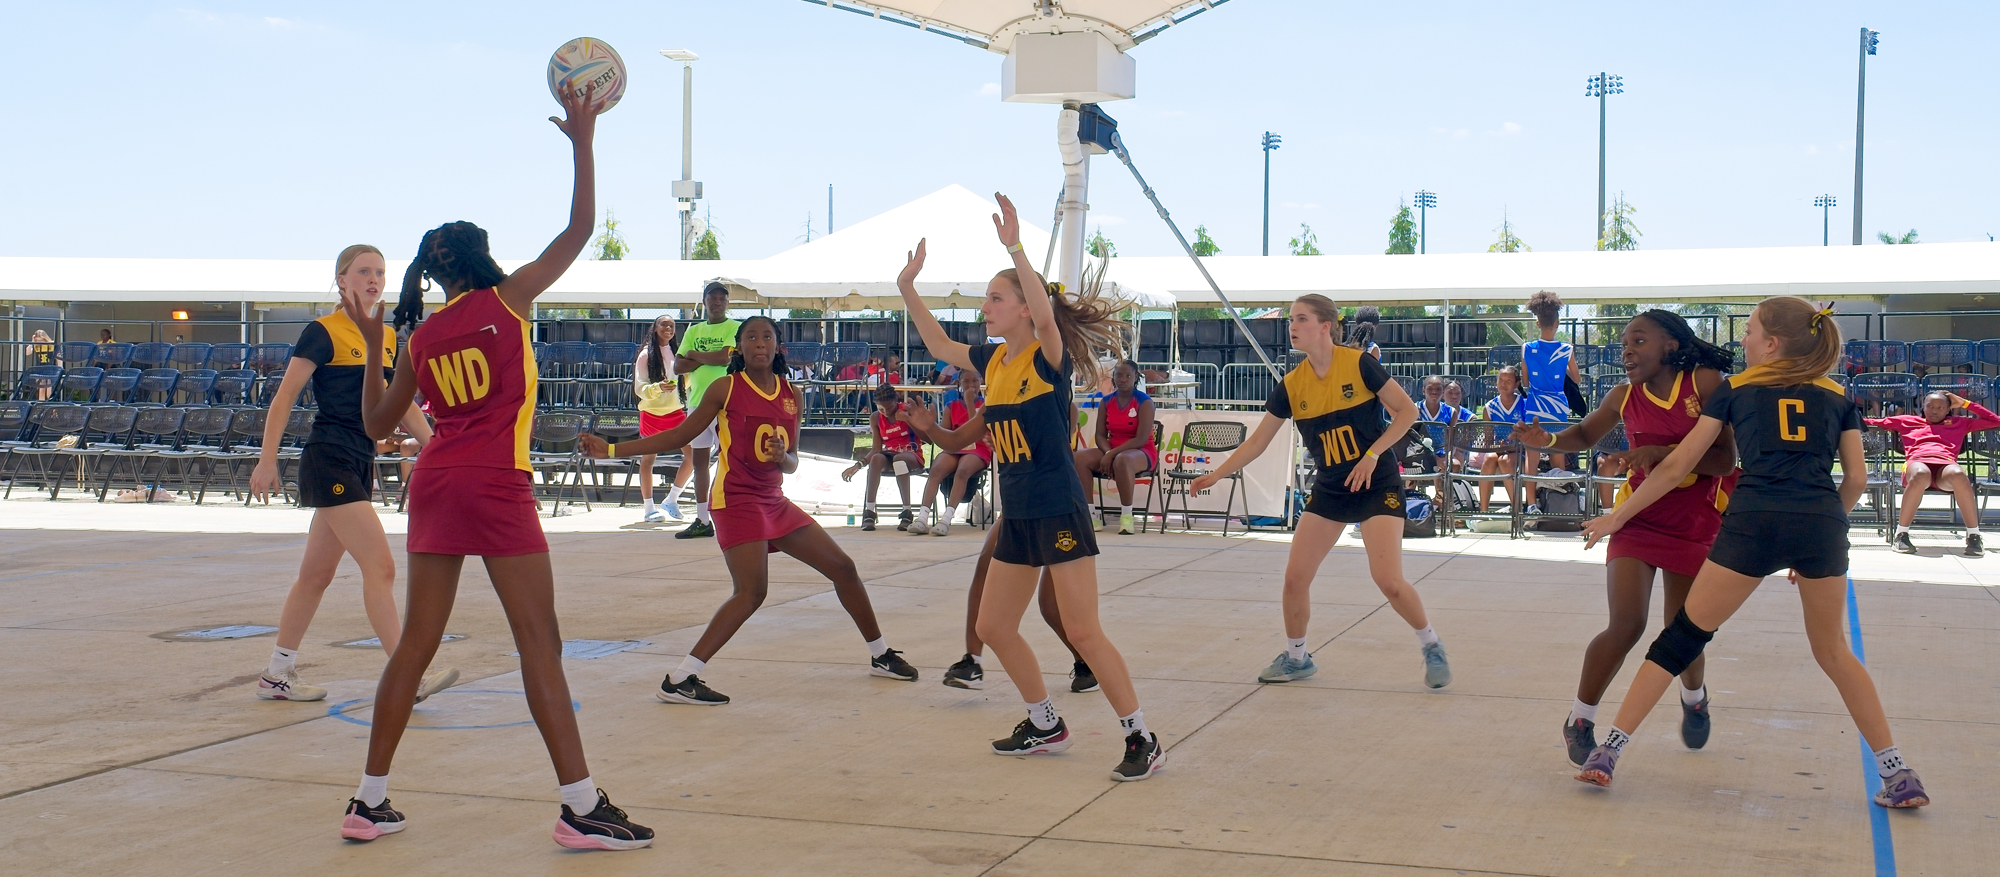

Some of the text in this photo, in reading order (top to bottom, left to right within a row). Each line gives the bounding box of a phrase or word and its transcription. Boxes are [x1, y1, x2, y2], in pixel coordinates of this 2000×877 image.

[427, 347, 490, 407] WD
[986, 419, 1031, 463] WA
[1778, 398, 1806, 441] C
[1164, 453, 1211, 464] Clssc
[1319, 425, 1360, 467] WD
